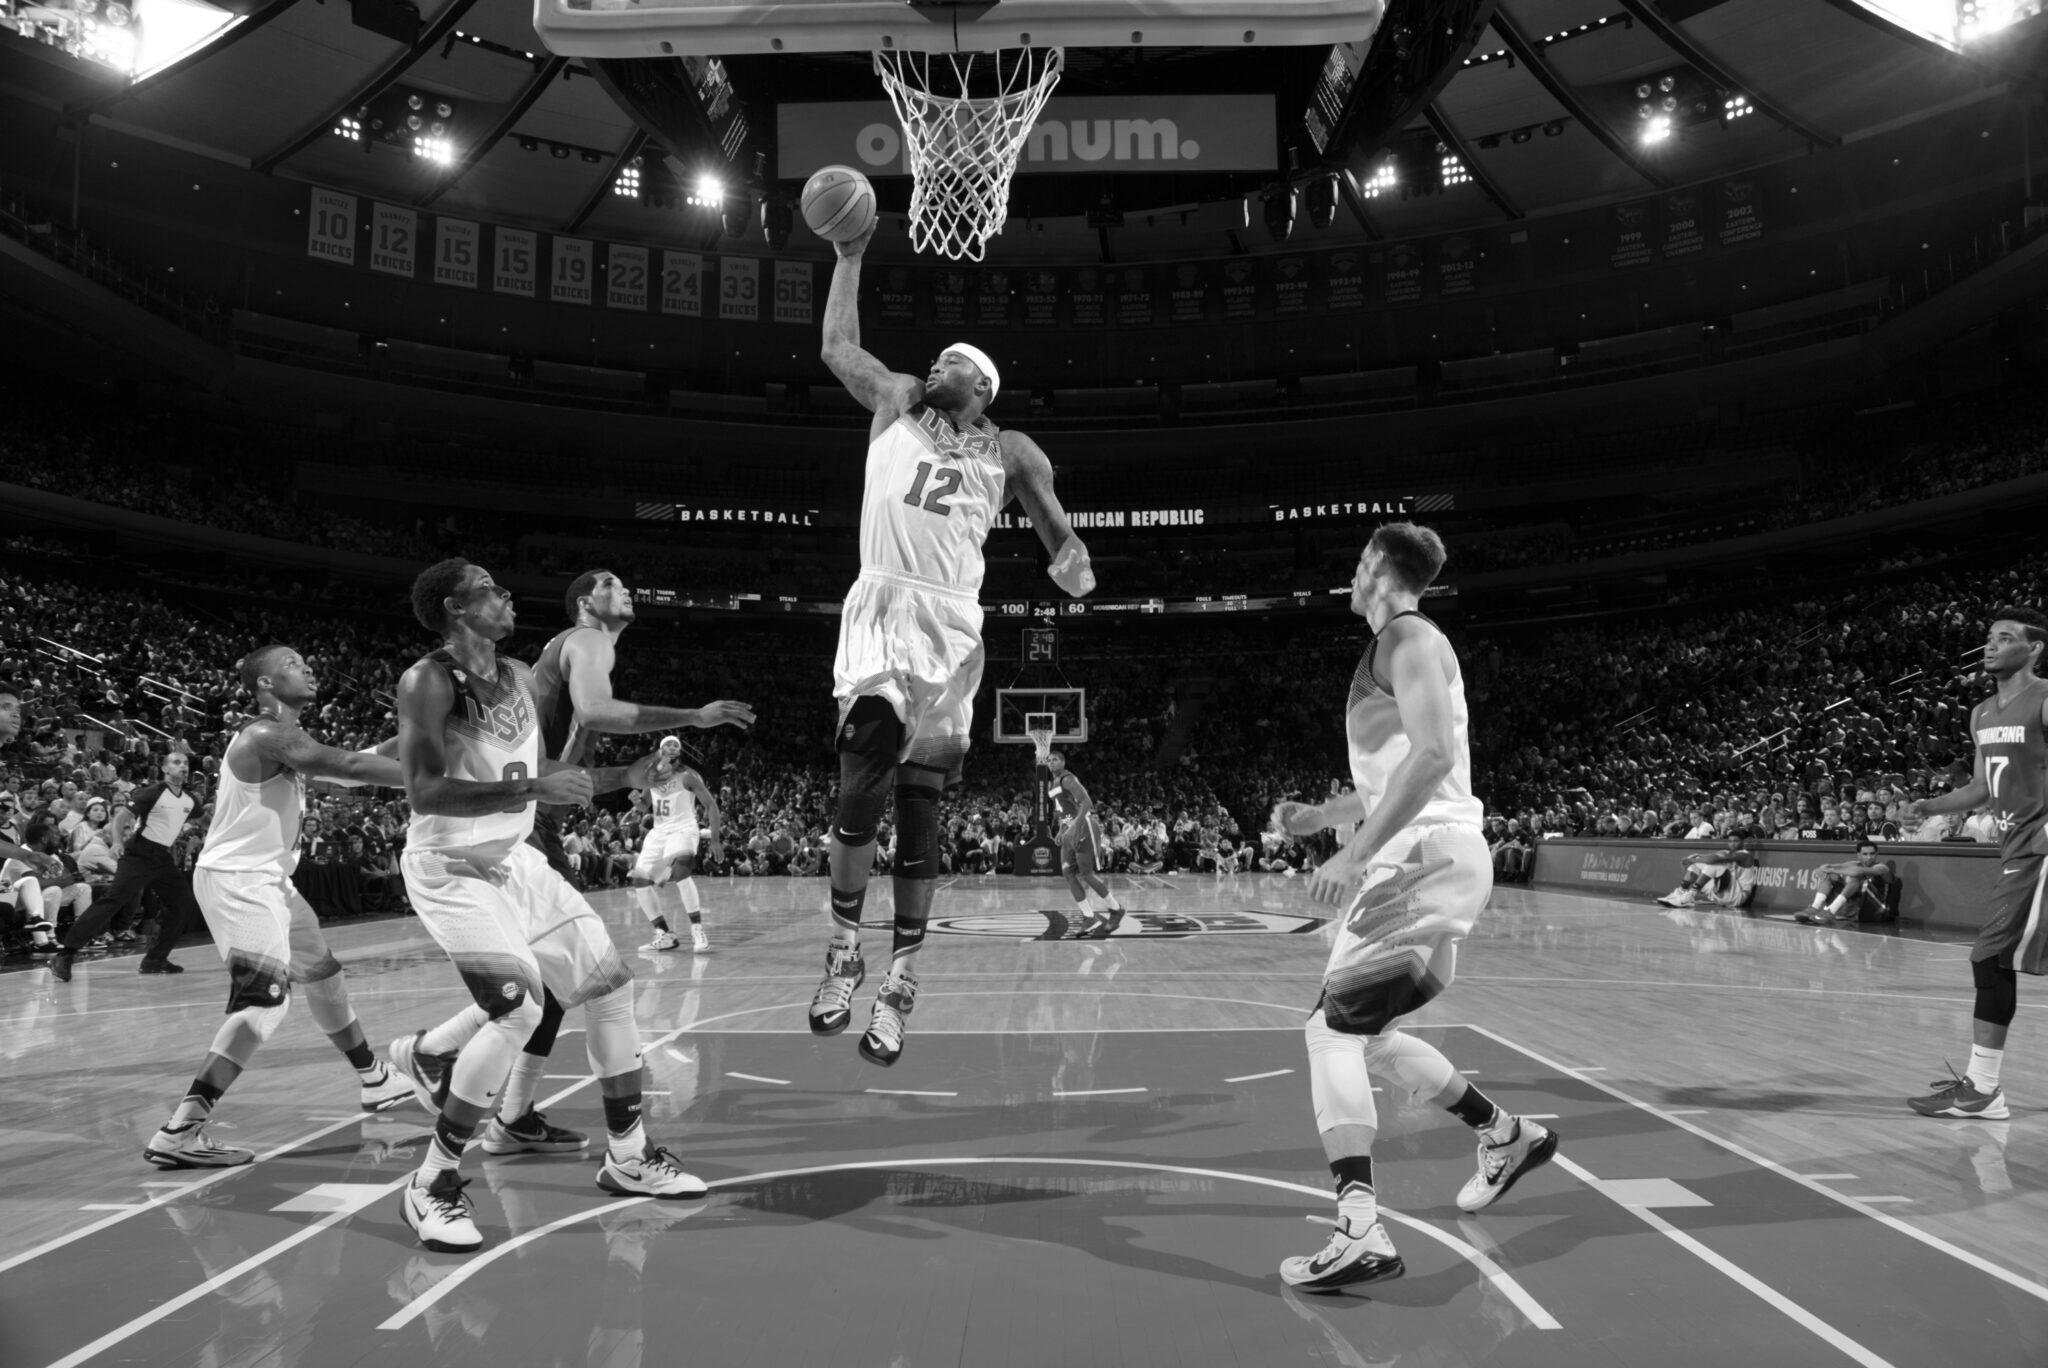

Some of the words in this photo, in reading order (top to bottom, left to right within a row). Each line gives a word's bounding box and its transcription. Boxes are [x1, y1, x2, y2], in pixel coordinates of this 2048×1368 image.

[317, 210, 348, 240] 10
[311, 239, 352, 258] KNICKS
[379, 224, 408, 254] 12
[443, 238, 471, 265] 15
[502, 248, 529, 274] 15
[373, 253, 412, 272] KNICKS
[559, 256, 585, 282] 19
[437, 267, 475, 283] KNICKS
[496, 275, 533, 291] KNICKS
[611, 264, 644, 290] 22
[666, 270, 697, 296] 24
[553, 285, 589, 299] KNICKS
[723, 276, 756, 300] 33
[776, 279, 811, 303] 613
[609, 291, 645, 305] KNICKS
[664, 297, 699, 312] KNICKS
[722, 303, 756, 316] KNICKS
[776, 307, 811, 319] KNICKS
[904, 461, 962, 516] 12
[681, 509, 812, 526] BASKETBALL
[1131, 508, 1204, 527] REPUBLIC
[1275, 502, 1407, 521] BASKETBALL
[1001, 604, 1025, 614] 100
[1034, 608, 1056, 616] 2:48
[1068, 603, 1085, 613] 60
[1033, 633, 1055, 643] 2:48
[1029, 643, 1052, 661] 24
[465, 695, 530, 745] USA
[1985, 756, 2010, 798] 17
[655, 799, 671, 817] 15
[1802, 829, 1817, 839] POSS
[1796, 869, 1809, 889] 14
